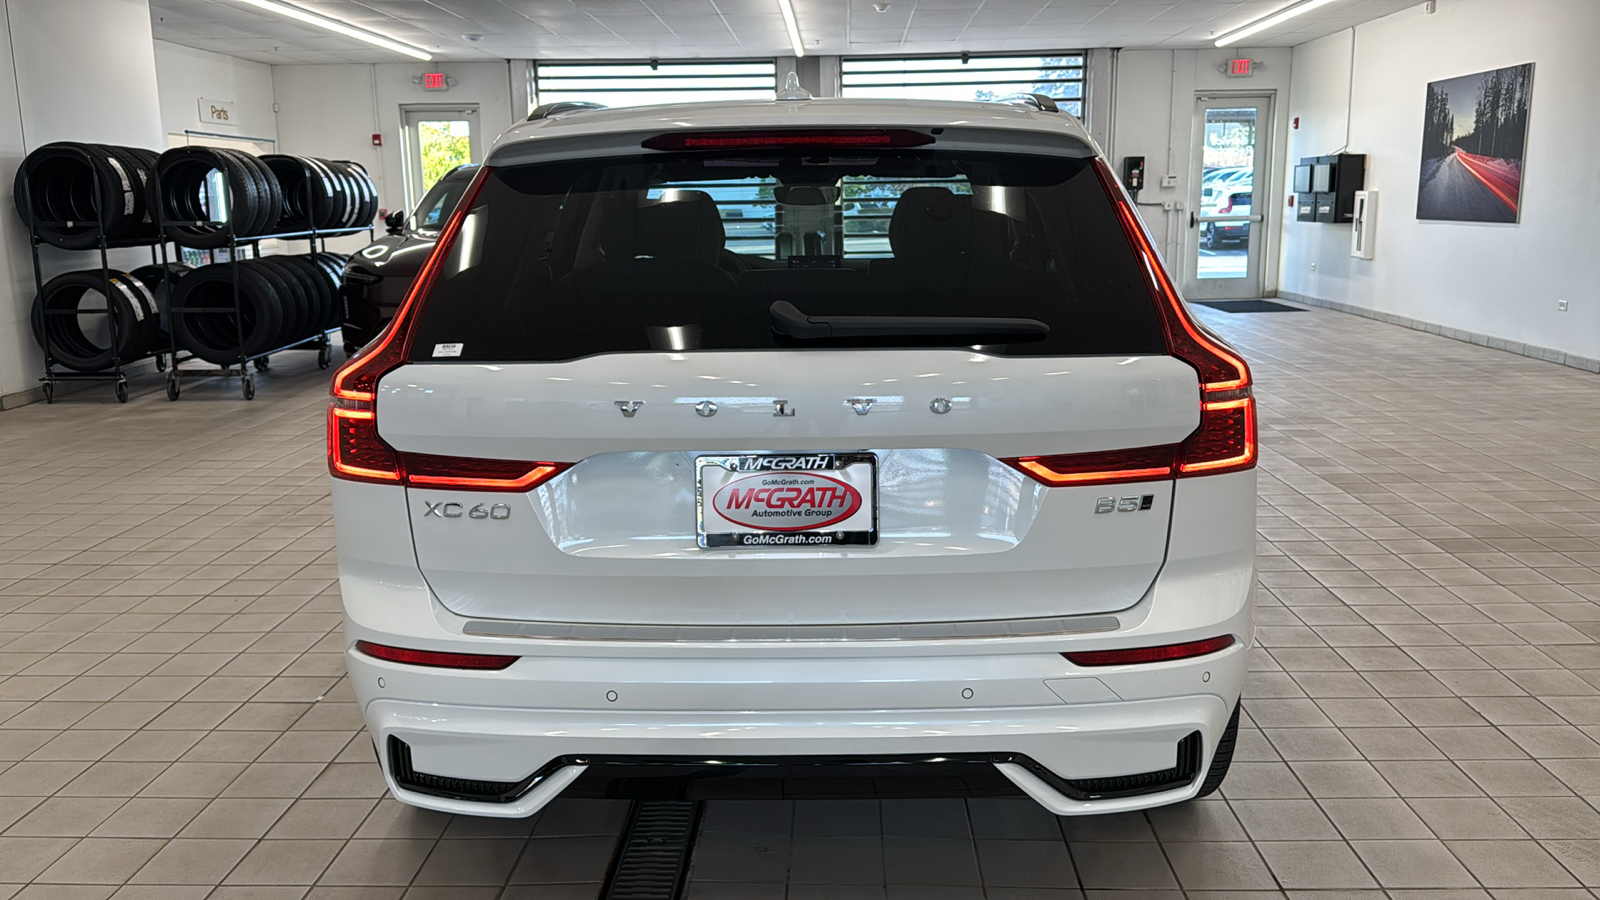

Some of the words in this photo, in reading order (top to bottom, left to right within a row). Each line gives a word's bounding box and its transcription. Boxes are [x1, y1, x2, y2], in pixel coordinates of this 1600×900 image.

[1232, 59, 1250, 74] EXIT
[425, 73, 444, 88] EXIT
[211, 105, 229, 121] Parts
[613, 397, 952, 418] VOLVO
[744, 456, 829, 470] McGRATH
[726, 487, 848, 510] McGRATH
[1094, 495, 1140, 514] B5
[751, 509, 803, 517] Automotive
[804, 509, 833, 518] Group
[743, 534, 832, 545] GoMcGrath.com
